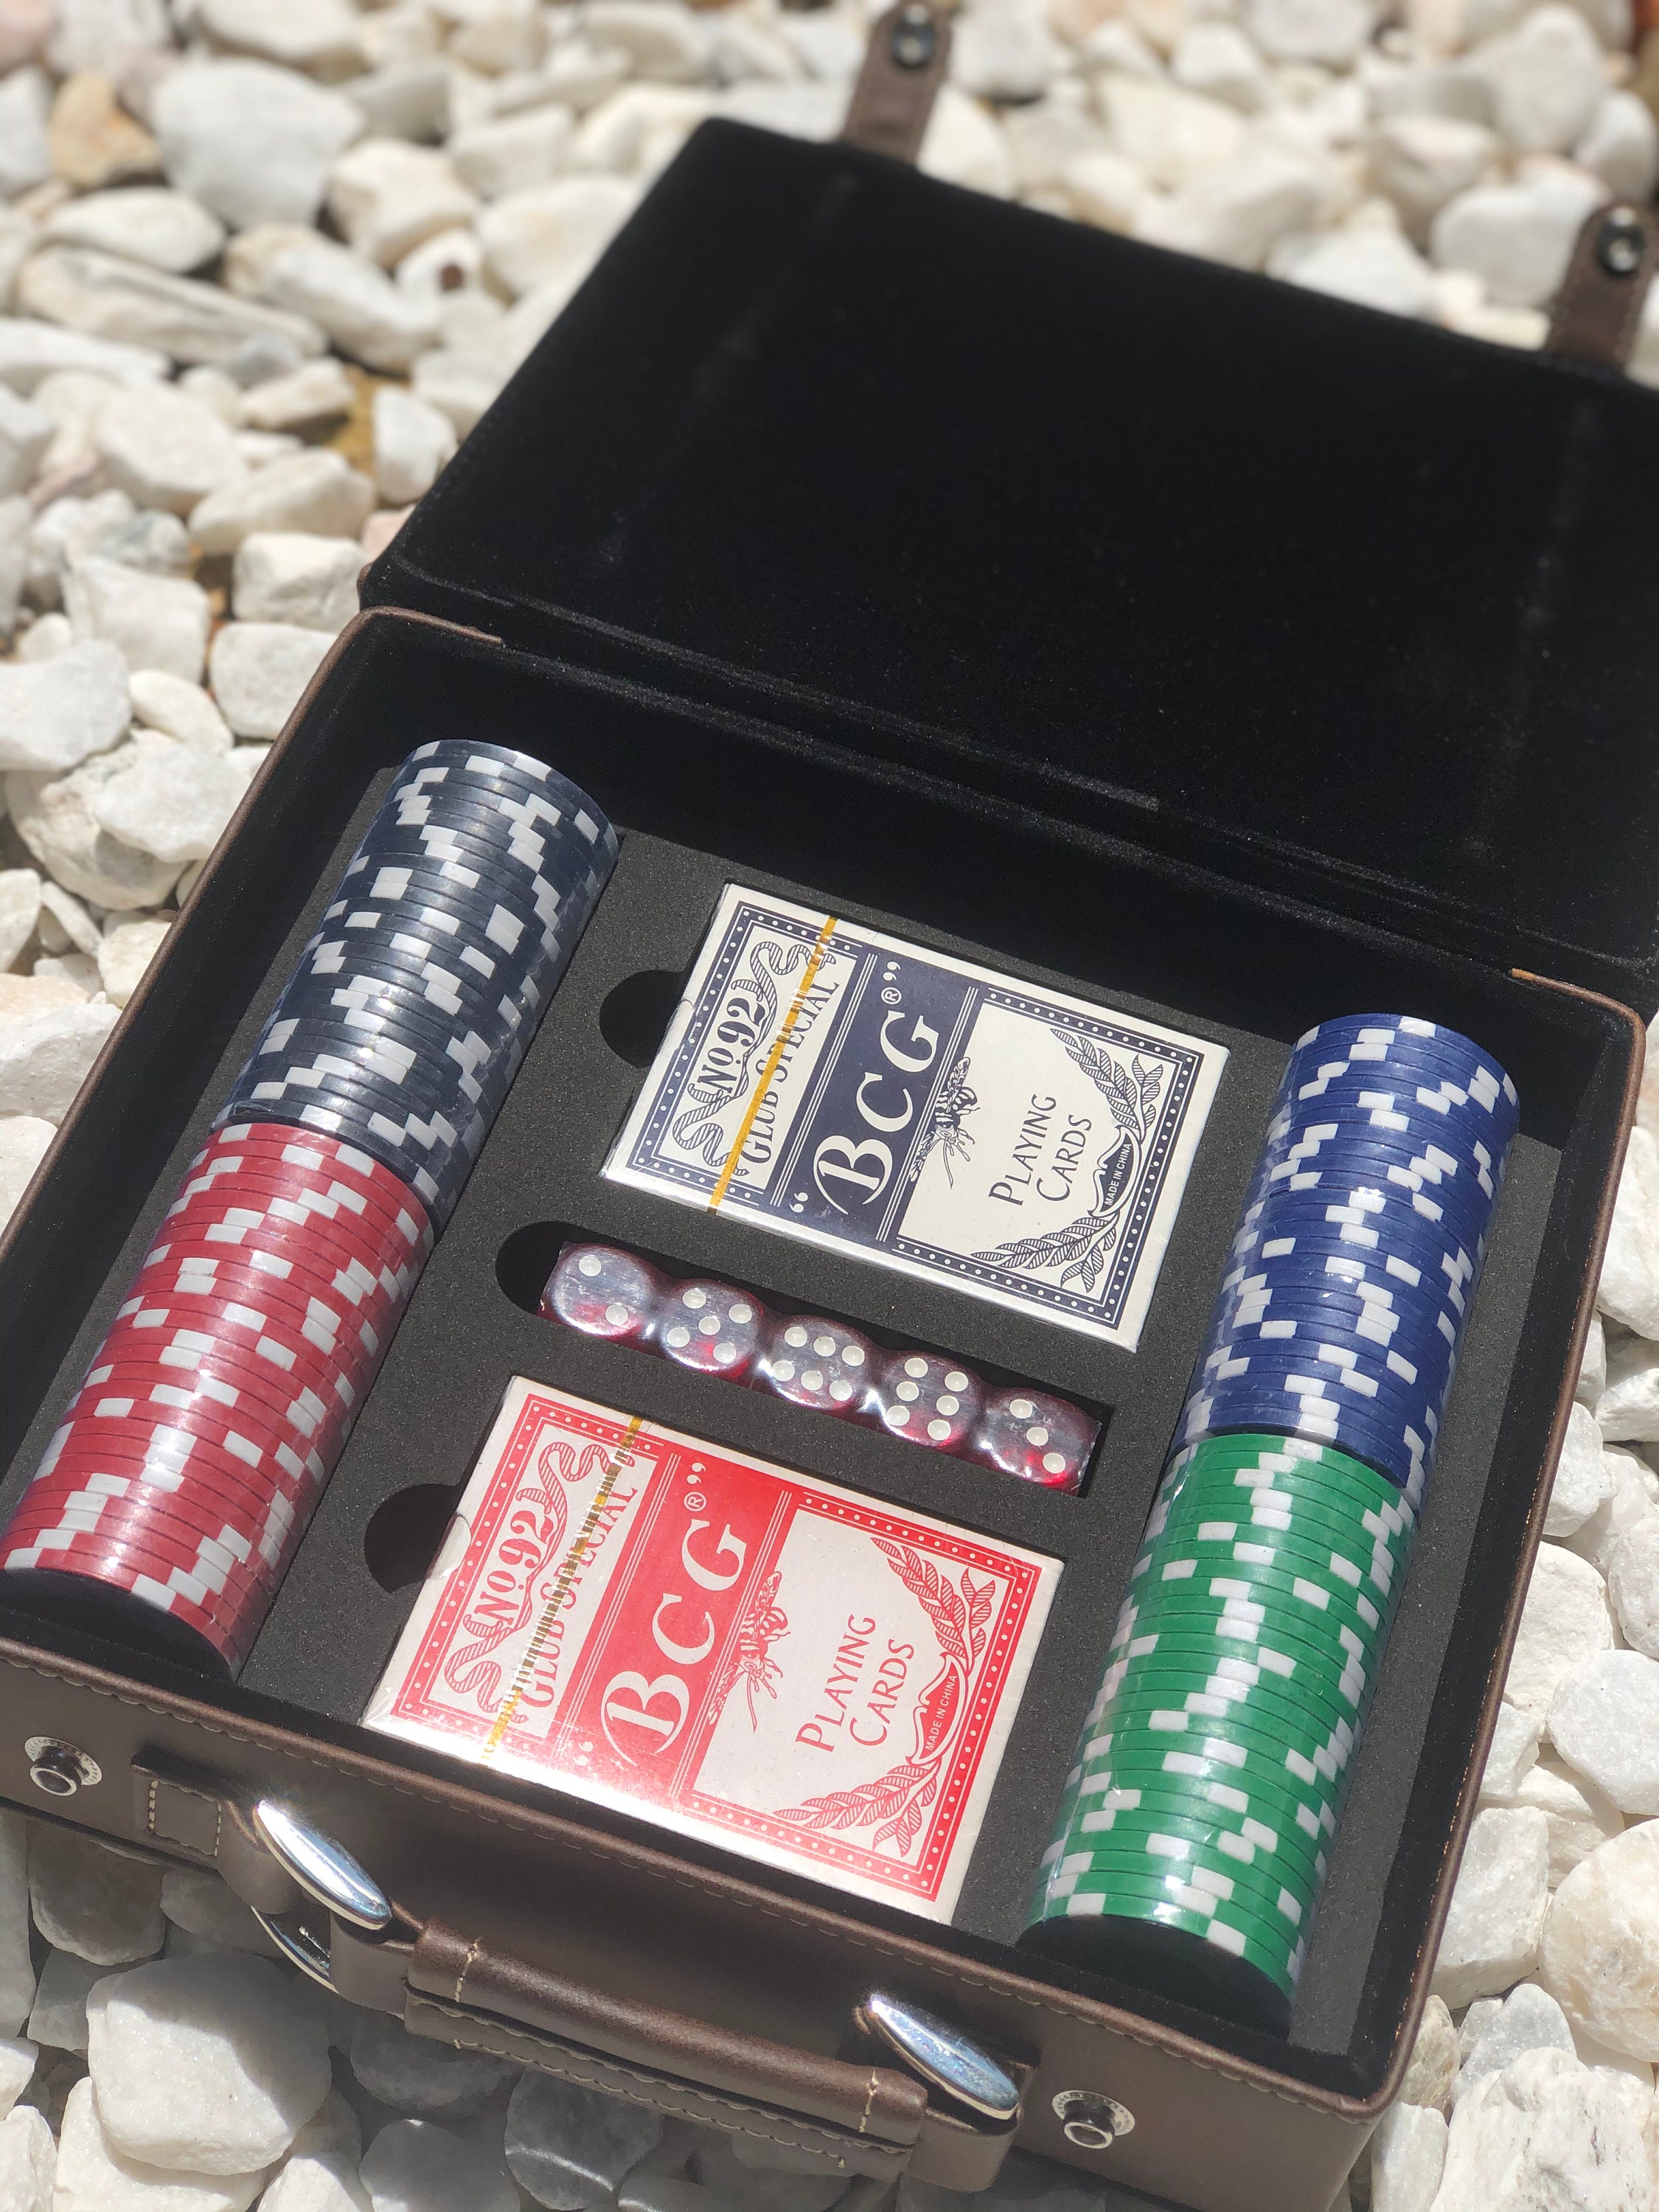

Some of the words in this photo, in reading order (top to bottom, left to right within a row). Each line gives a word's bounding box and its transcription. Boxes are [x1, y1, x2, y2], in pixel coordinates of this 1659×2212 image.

[988, 1093, 1057, 1206] PLAYING
[1036, 1114, 1092, 1202] CARDS
[1116, 1144, 1133, 1169] CHINA
[1113, 1170, 1123, 1180] IN
[1104, 1180, 1120, 1206] MADE
[795, 1614, 876, 1752] PLAYING
[849, 1638, 914, 1746] CARDS
[939, 1675, 958, 1707] CHINA
[936, 1708, 946, 1719] IN
[925, 1720, 942, 1751] MADE
